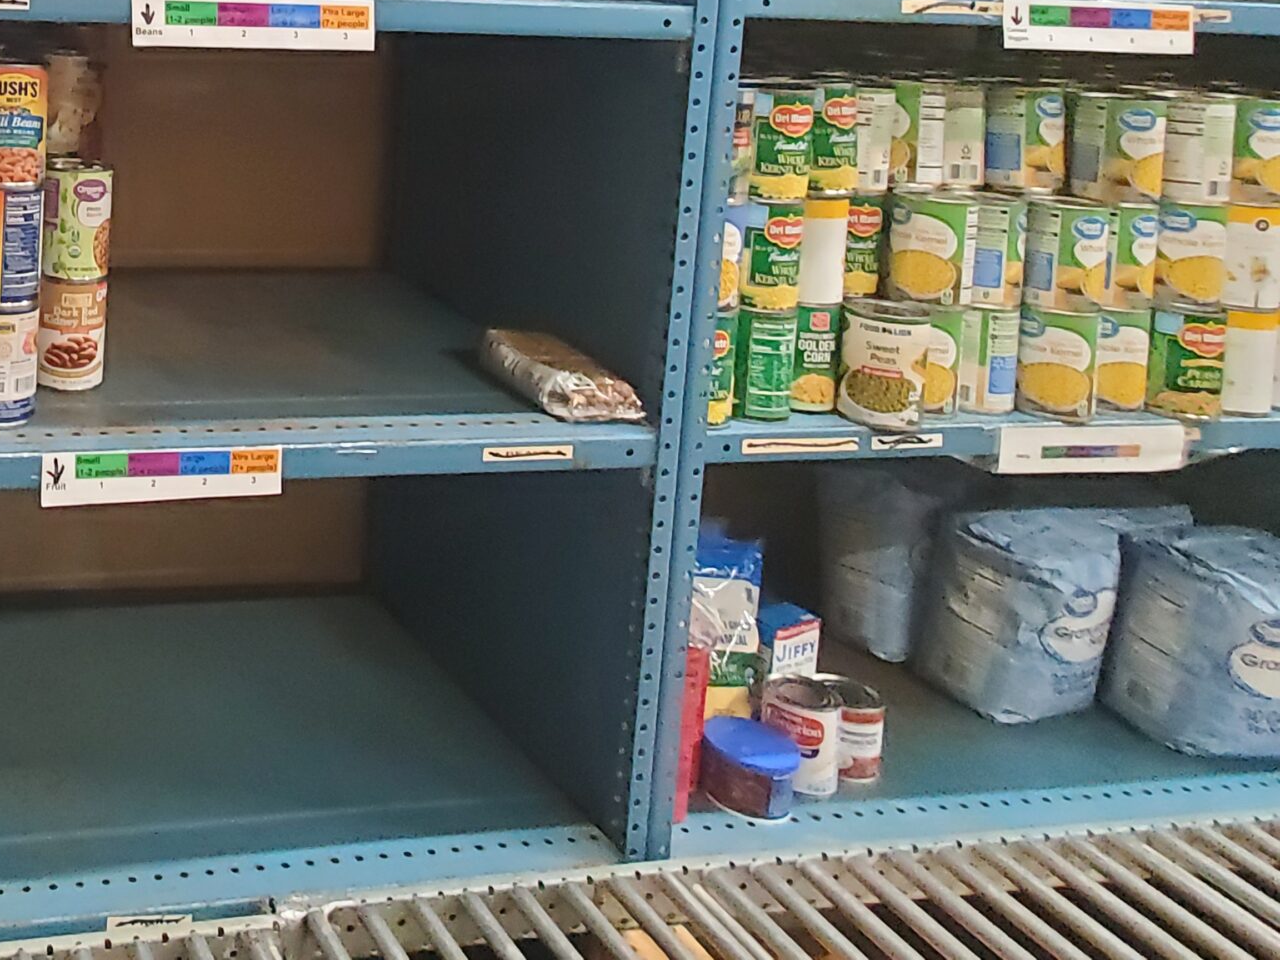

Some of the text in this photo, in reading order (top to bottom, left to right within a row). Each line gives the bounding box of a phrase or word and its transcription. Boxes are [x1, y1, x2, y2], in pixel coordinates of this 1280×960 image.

[165, 3, 191, 13] Small
[340, 8, 366, 19] Large
[337, 19, 369, 30] people)
[135, 26, 163, 36] Beans
[798, 339, 836, 352] GOLDEN
[865, 340, 900, 355] Sweet
[803, 351, 832, 364] CORN
[869, 352, 897, 366] Peas
[250, 452, 275, 463] Large
[45, 482, 67, 491] Fruit
[776, 640, 816, 663] JIFFY
